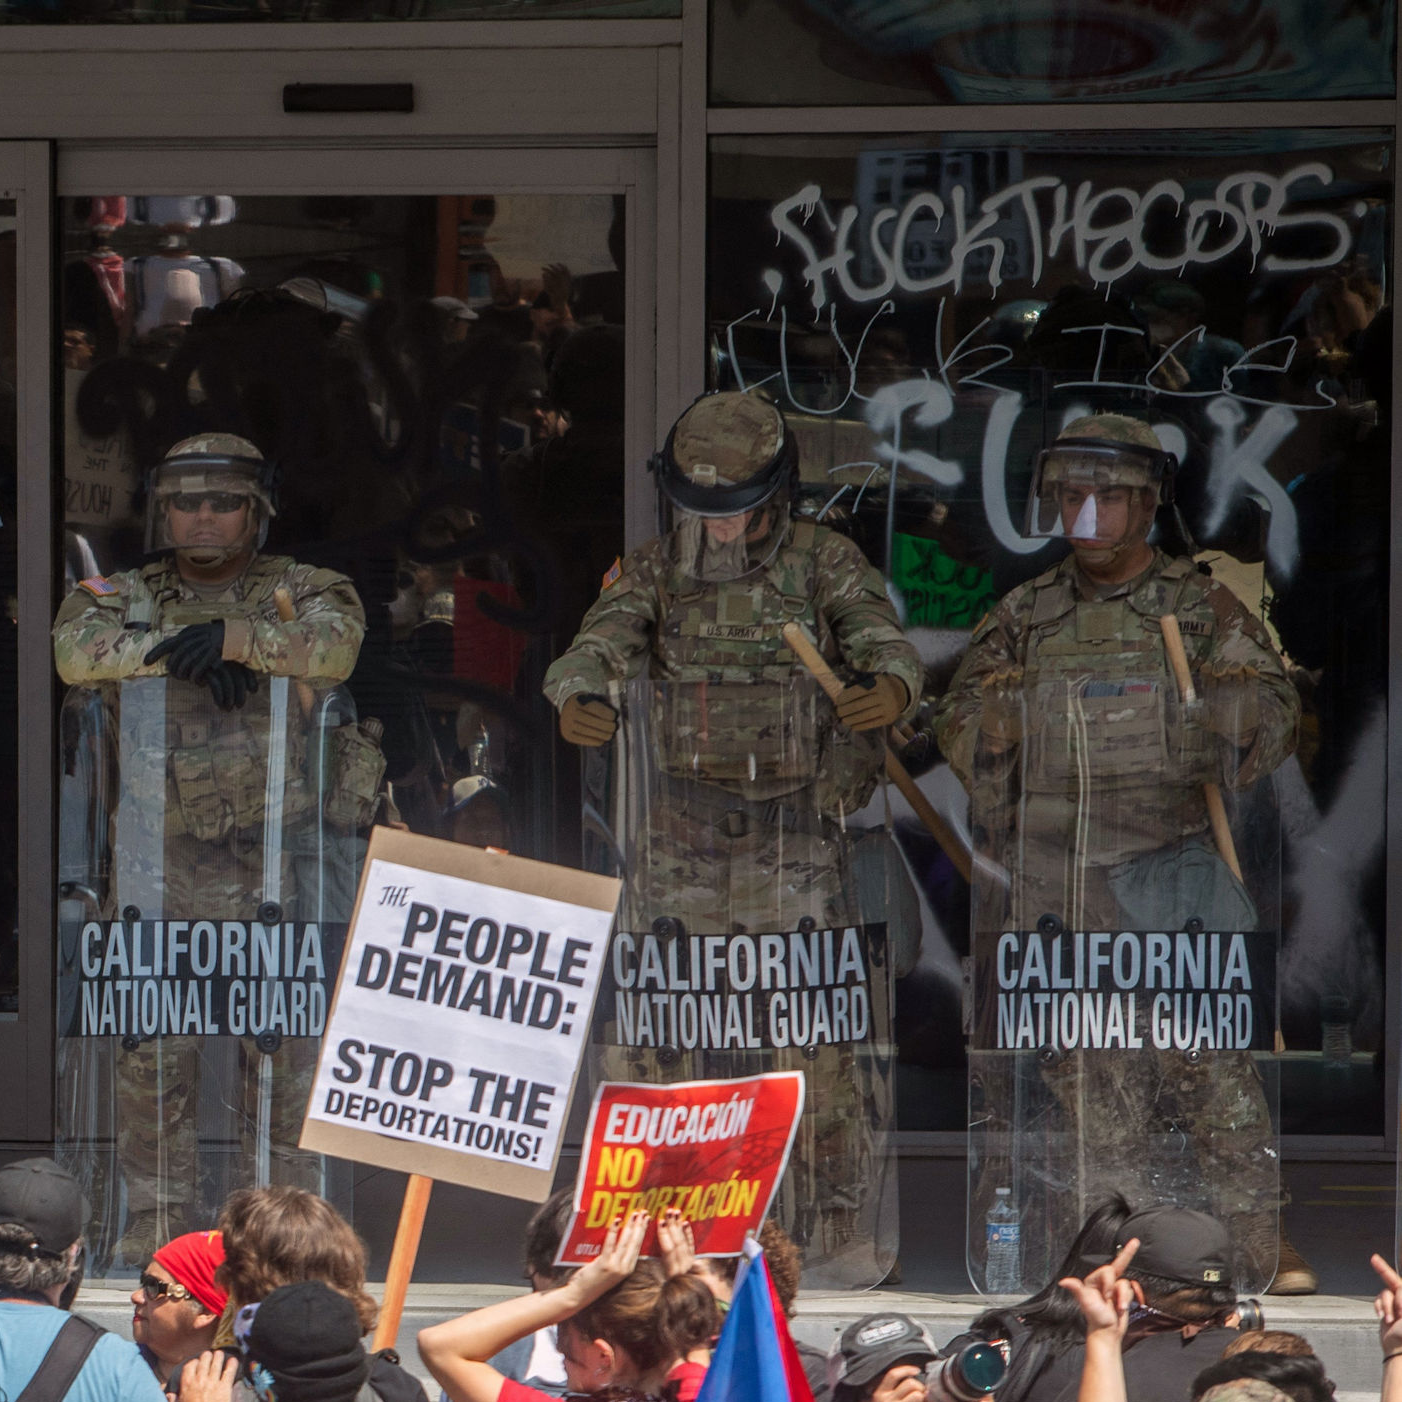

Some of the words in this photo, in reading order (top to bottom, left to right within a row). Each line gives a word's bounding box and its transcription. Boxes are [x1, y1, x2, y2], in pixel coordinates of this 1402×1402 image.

[727, 627, 757, 639] ARMY
[378, 885, 414, 907] THE
[81, 922, 323, 979] CALIFORNIA
[401, 902, 593, 988] PEOPLE
[612, 927, 865, 993] CALIFORNIA
[997, 932, 1251, 991] CALIFORNIA
[81, 980, 221, 1036] NATIONAL
[228, 982, 326, 1036] GUARD
[355, 943, 577, 1035] DEMAND:
[616, 990, 763, 1050] NATIONAL
[768, 985, 870, 1046] GUARD
[997, 992, 1142, 1049] NATIONAL
[1151, 993, 1253, 1050] GUARD
[332, 1039, 454, 1102] STOP
[468, 1068, 556, 1129] THE
[324, 1088, 543, 1162] DEPORTATIONS!
[603, 1091, 754, 1147] EDUCACIÓN
[595, 1146, 646, 1187] NO
